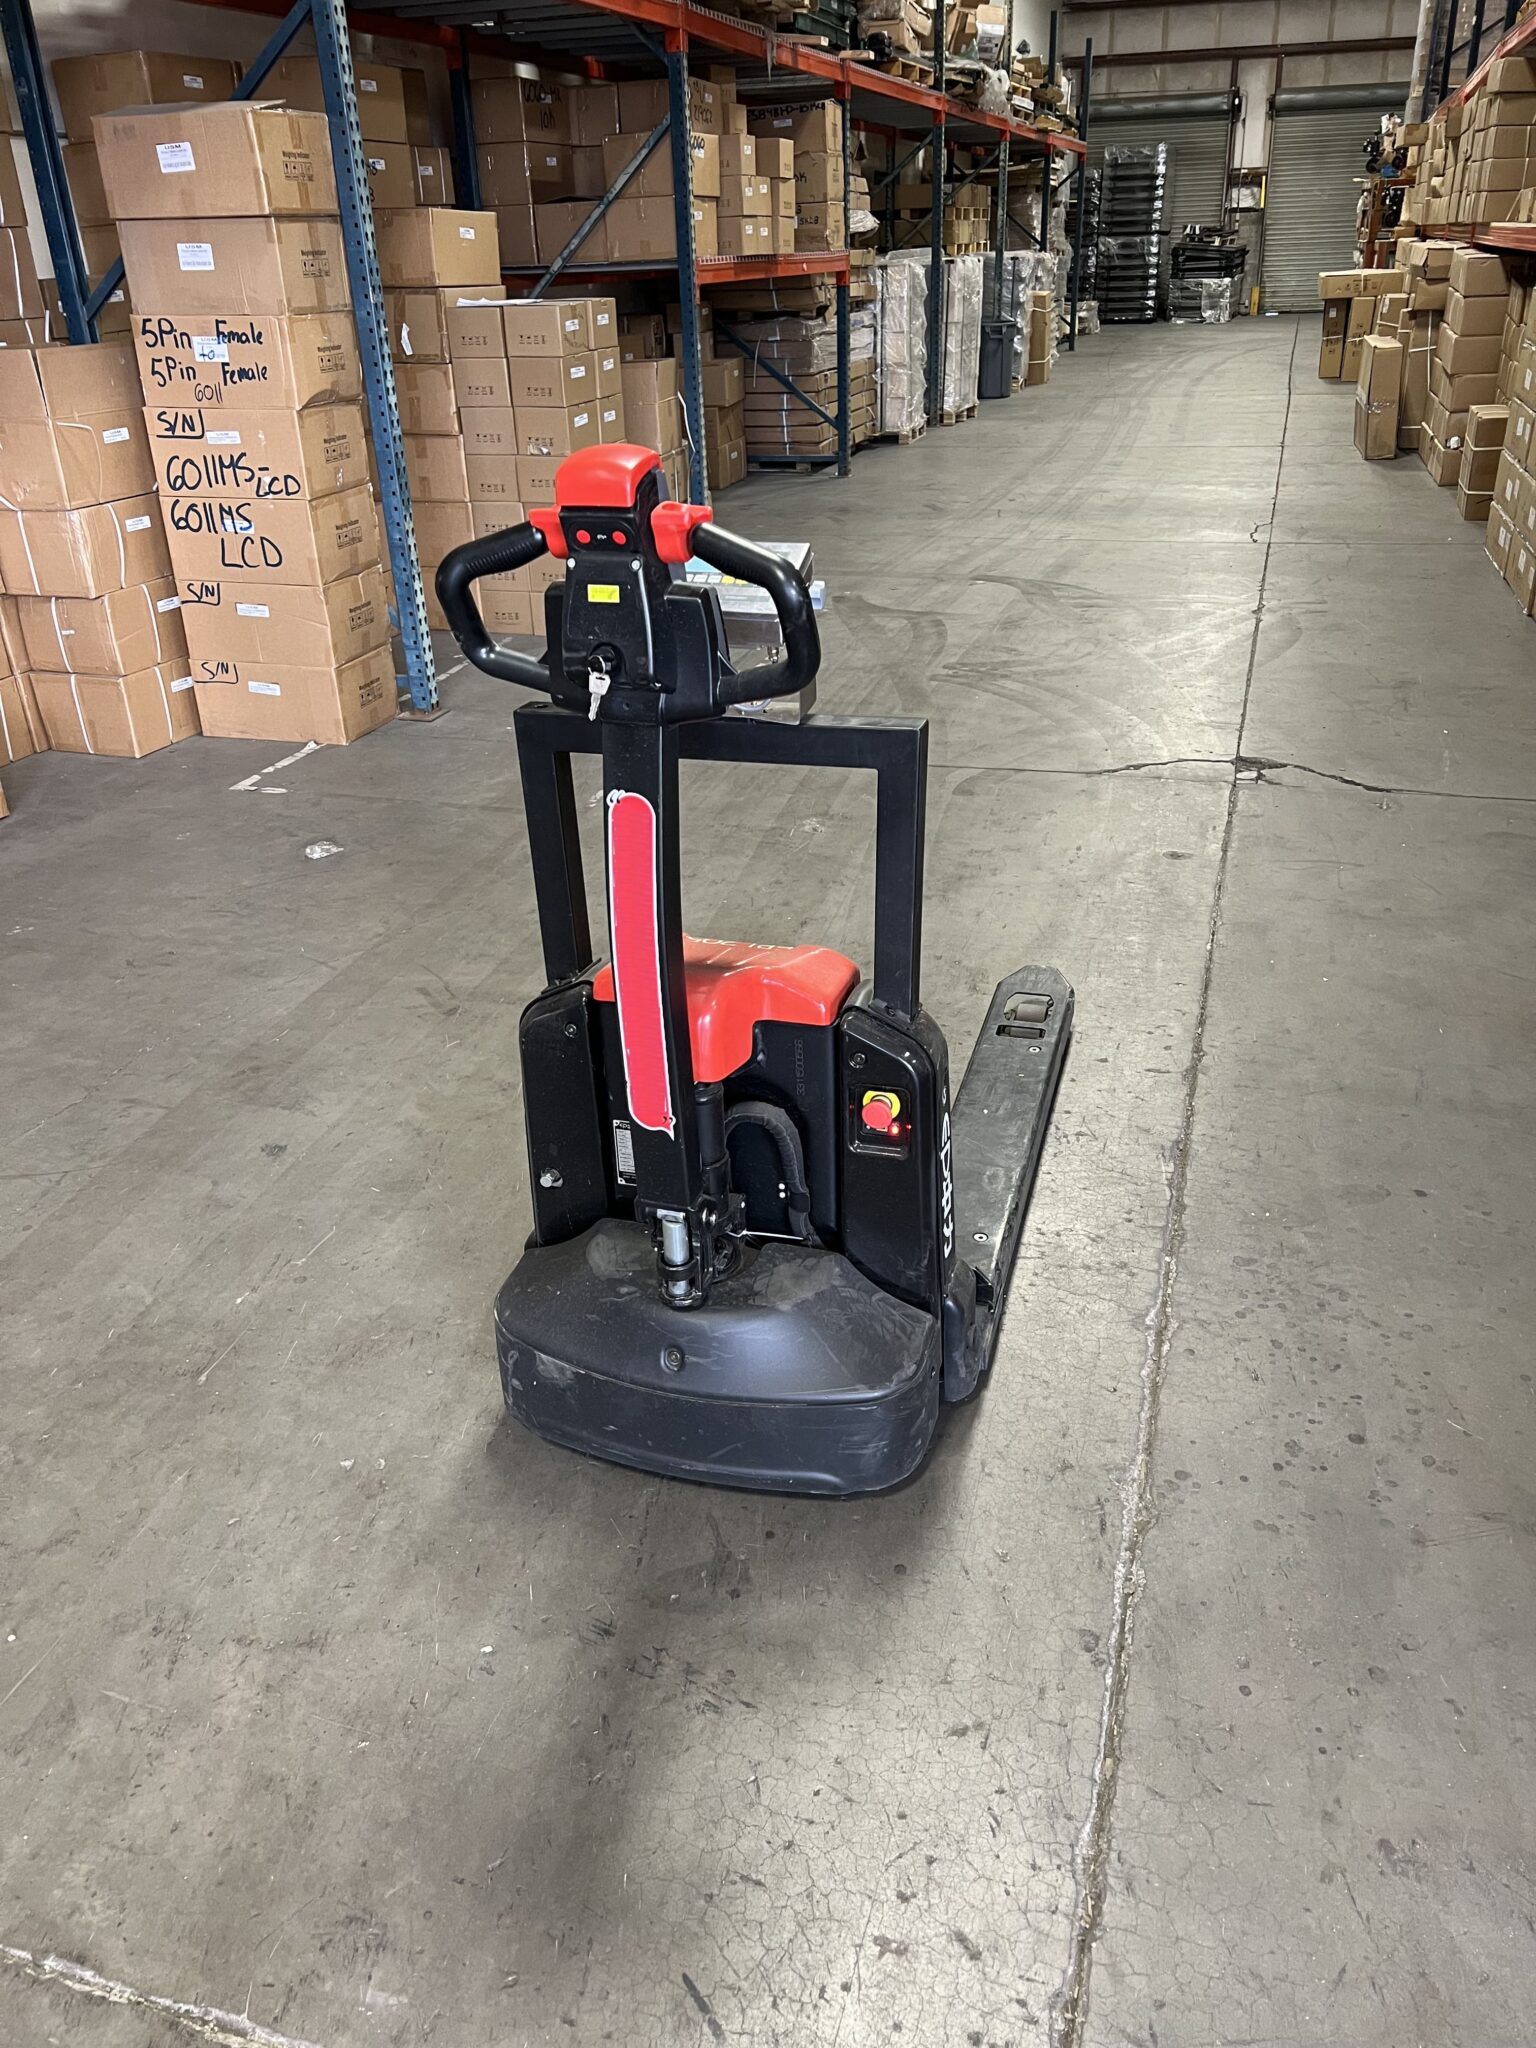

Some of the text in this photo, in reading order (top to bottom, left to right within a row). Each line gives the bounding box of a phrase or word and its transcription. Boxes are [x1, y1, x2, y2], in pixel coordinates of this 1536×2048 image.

[141, 317, 264, 350] 5Pin Female
[151, 355, 269, 388] 5Pin Female
[194, 381, 224, 404] 6011
[156, 410, 197, 435] S/N
[255, 474, 302, 498] LCD
[170, 498, 253, 535] 6011MS
[221, 535, 284, 569] LCD
[186, 582, 216, 602] S/N
[201, 661, 229, 680] S/N
